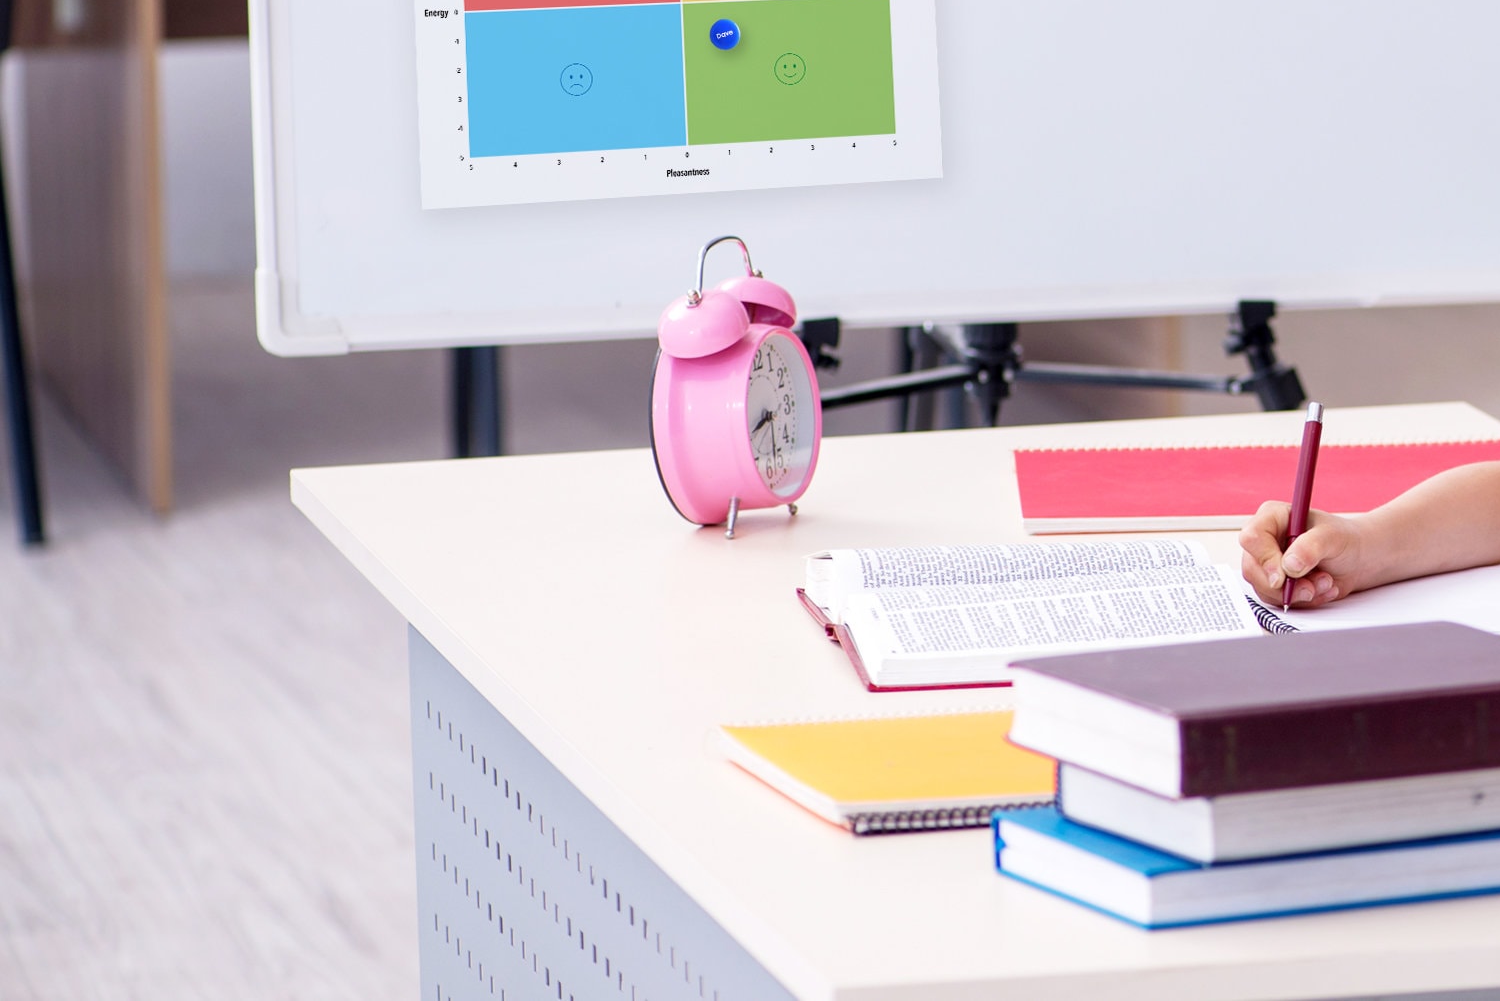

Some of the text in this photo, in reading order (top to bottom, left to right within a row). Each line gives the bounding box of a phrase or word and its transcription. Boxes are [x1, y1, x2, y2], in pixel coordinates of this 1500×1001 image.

[424, 9, 449, 19] Energy
[666, 168, 710, 178] Pleasantness
[767, 352, 774, 373] 1
[777, 367, 785, 389] 2
[783, 394, 791, 415] 3
[782, 422, 789, 444] 4
[766, 457, 773, 479] 6
[776, 447, 784, 469] 5
